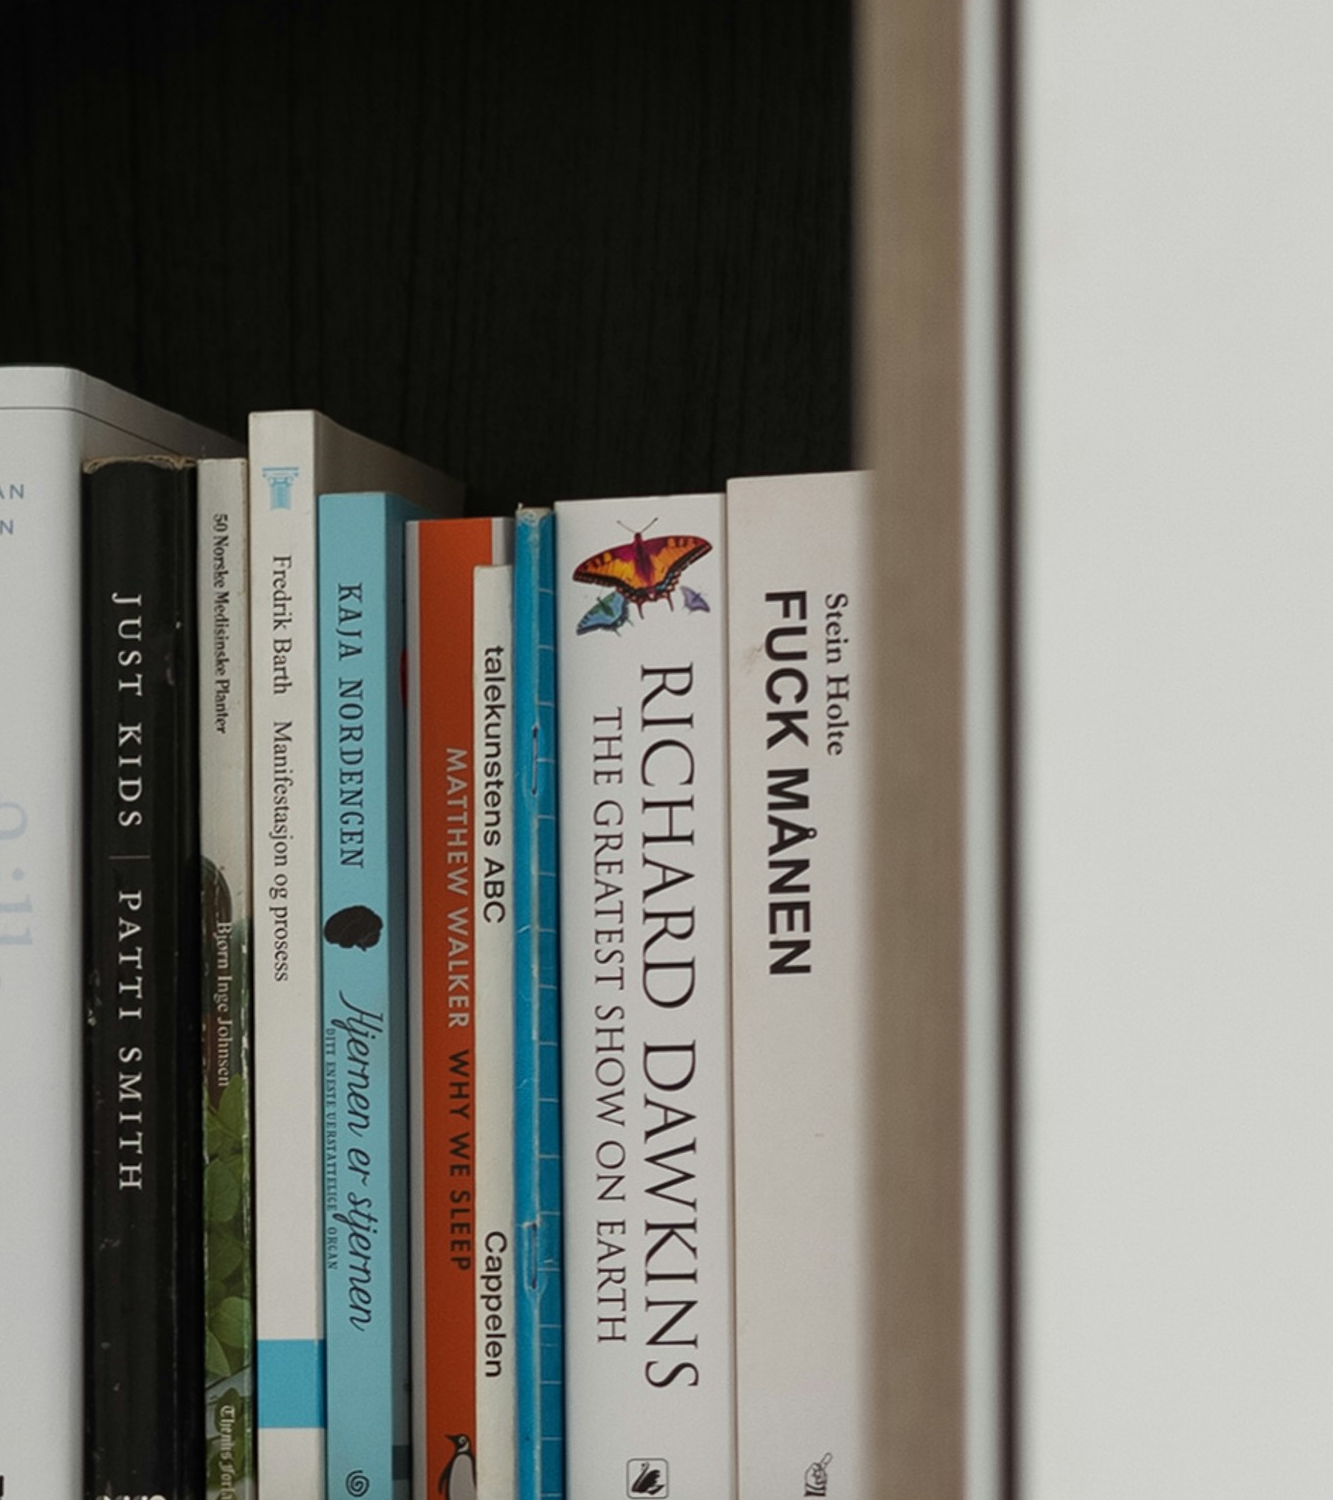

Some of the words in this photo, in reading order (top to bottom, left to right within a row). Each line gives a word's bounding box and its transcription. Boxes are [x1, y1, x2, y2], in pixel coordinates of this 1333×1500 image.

[213, 512, 230, 532] 50
[213, 535, 230, 588] Norske
[112, 592, 143, 697] JUST
[214, 591, 230, 675] Medisinske
[273, 554, 293, 631] Fredrik
[336, 581, 363, 662] KAJA
[824, 592, 850, 665] Stein
[215, 679, 231, 735] Planter
[273, 638, 293, 696] Barth
[764, 589, 810, 750] FUCK
[826, 673, 850, 756] Holte
[117, 722, 142, 829] KIDS
[266, 720, 294, 867] Manifestasjon
[336, 676, 364, 869] NORDENGEN
[483, 645, 507, 847] talekunstens
[593, 706, 624, 787] THE
[446, 746, 469, 896] MATTHEW
[640, 661, 697, 1010] RICHARD
[766, 767, 818, 976] MÅNEN
[268, 872, 288, 900] og
[483, 856, 506, 924] ABC
[594, 800, 626, 991] GREATEST
[117, 890, 143, 1020] PATTI
[267, 906, 288, 982] prosess
[447, 906, 470, 1028] WALKER
[331, 990, 384, 1136] Hjernen
[449, 1049, 471, 1120] WHY
[595, 1005, 627, 1128] SHOW
[117, 1046, 143, 1191] SMITH
[347, 1149, 371, 1186] er
[449, 1130, 471, 1177] WE
[595, 1140, 627, 1202] ON
[333, 1191, 380, 1332] stjernen
[450, 1190, 472, 1271] SLEEP
[642, 1040, 699, 1389] DAWKINS
[479, 1230, 508, 1379] Cappelen
[596, 1220, 627, 1343] EARTH
